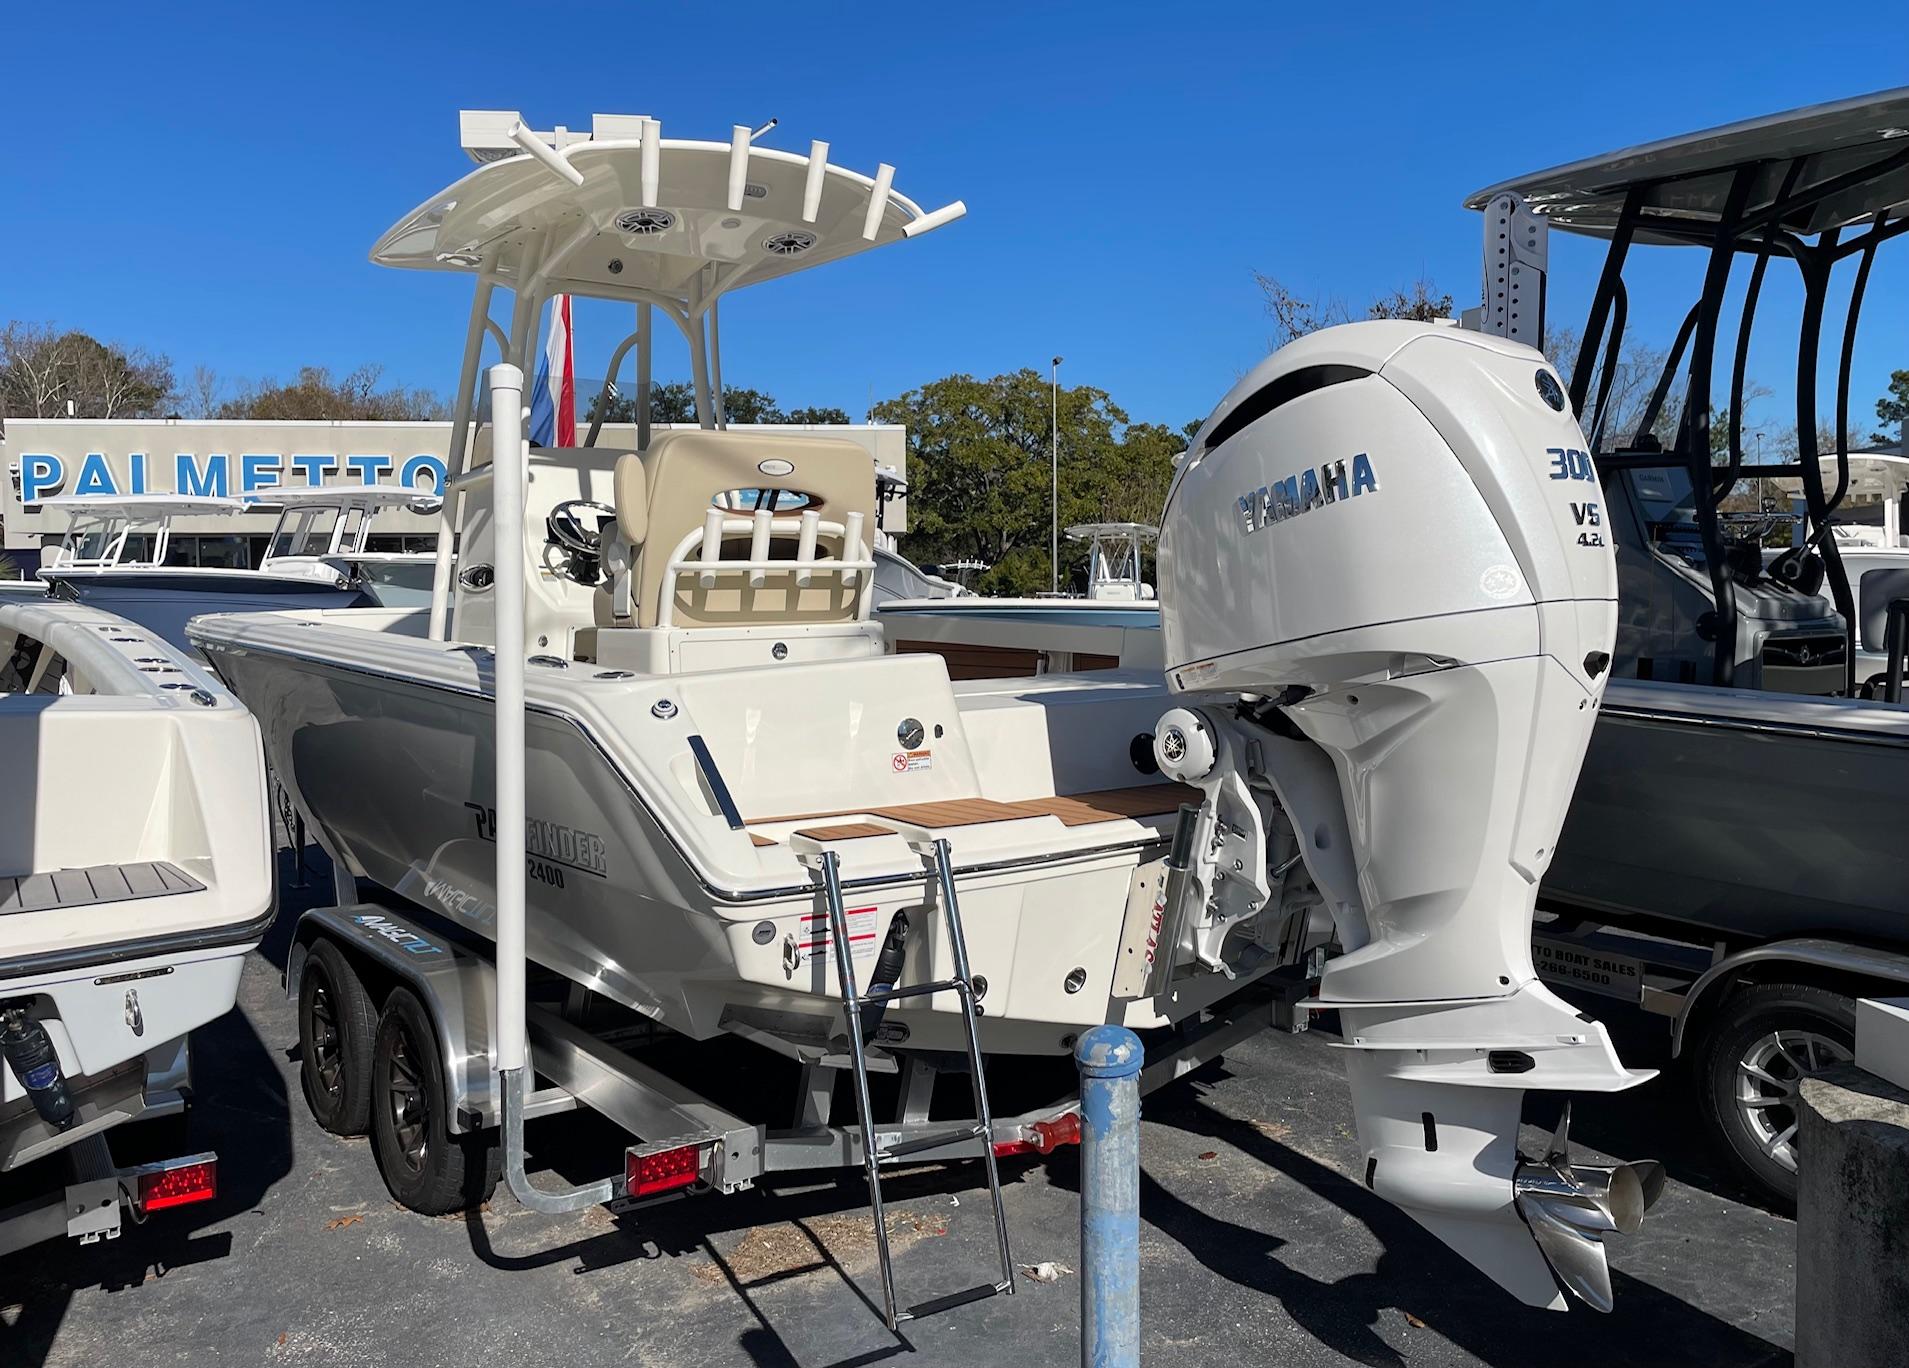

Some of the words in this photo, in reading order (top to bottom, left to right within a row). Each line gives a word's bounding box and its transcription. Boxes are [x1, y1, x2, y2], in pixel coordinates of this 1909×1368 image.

[20, 453, 448, 513] PALMETTO
[1546, 448, 1595, 483] 300
[1234, 452, 1380, 537] YAMAHA
[1570, 502, 1600, 526] V6
[464, 802, 607, 874] PAFINDER
[527, 858, 565, 889] 2400
[1532, 944, 1552, 958] TO
[1555, 949, 1590, 966] BOAT
[1593, 959, 1635, 976] SALES
